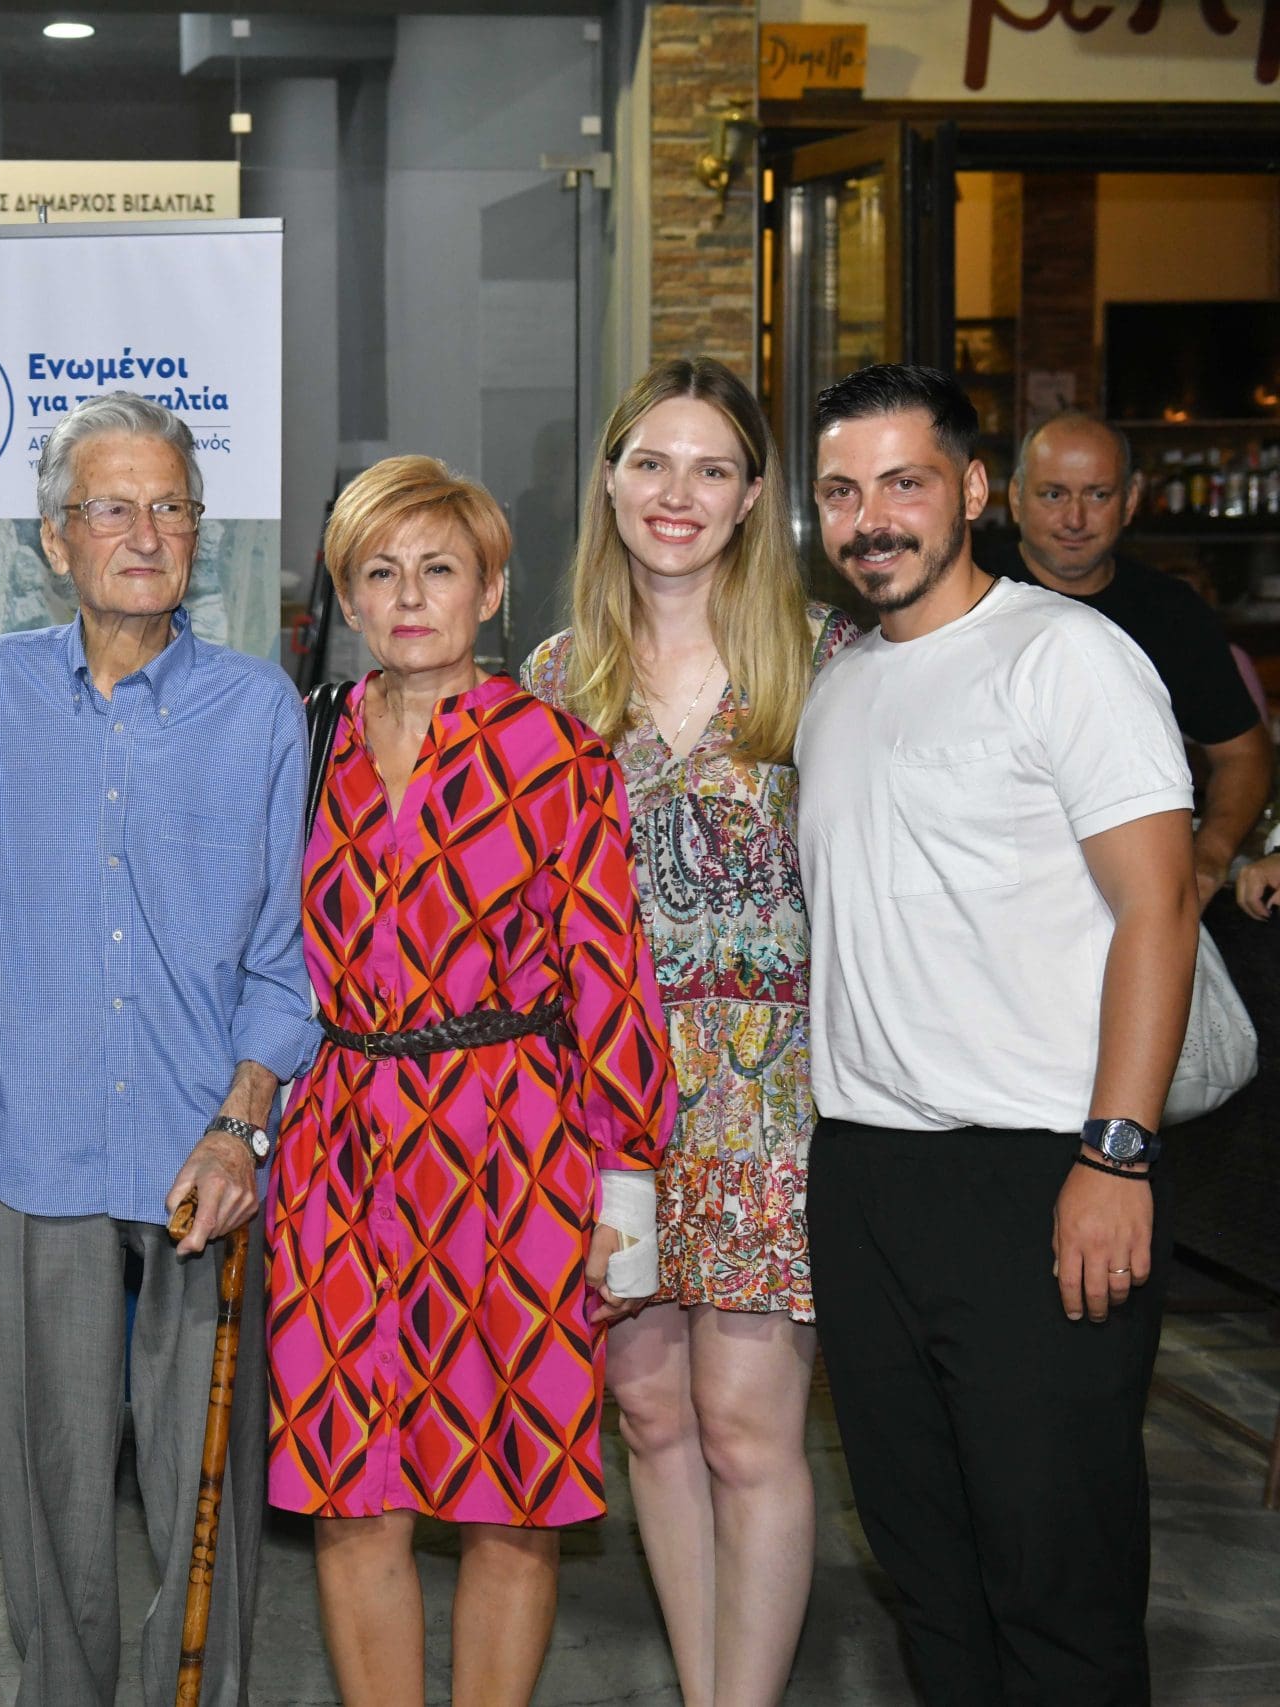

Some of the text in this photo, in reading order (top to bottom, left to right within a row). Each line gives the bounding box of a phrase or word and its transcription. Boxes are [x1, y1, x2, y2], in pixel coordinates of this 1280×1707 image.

[14, 193, 116, 212] ΔΗΜΑΡΧΟΣ
[123, 192, 216, 212] ΒΙΣΑΛΤΙΑΣ
[28, 347, 188, 386] Ενωμένοι
[27, 395, 68, 417] για
[143, 385, 229, 411] αλτία
